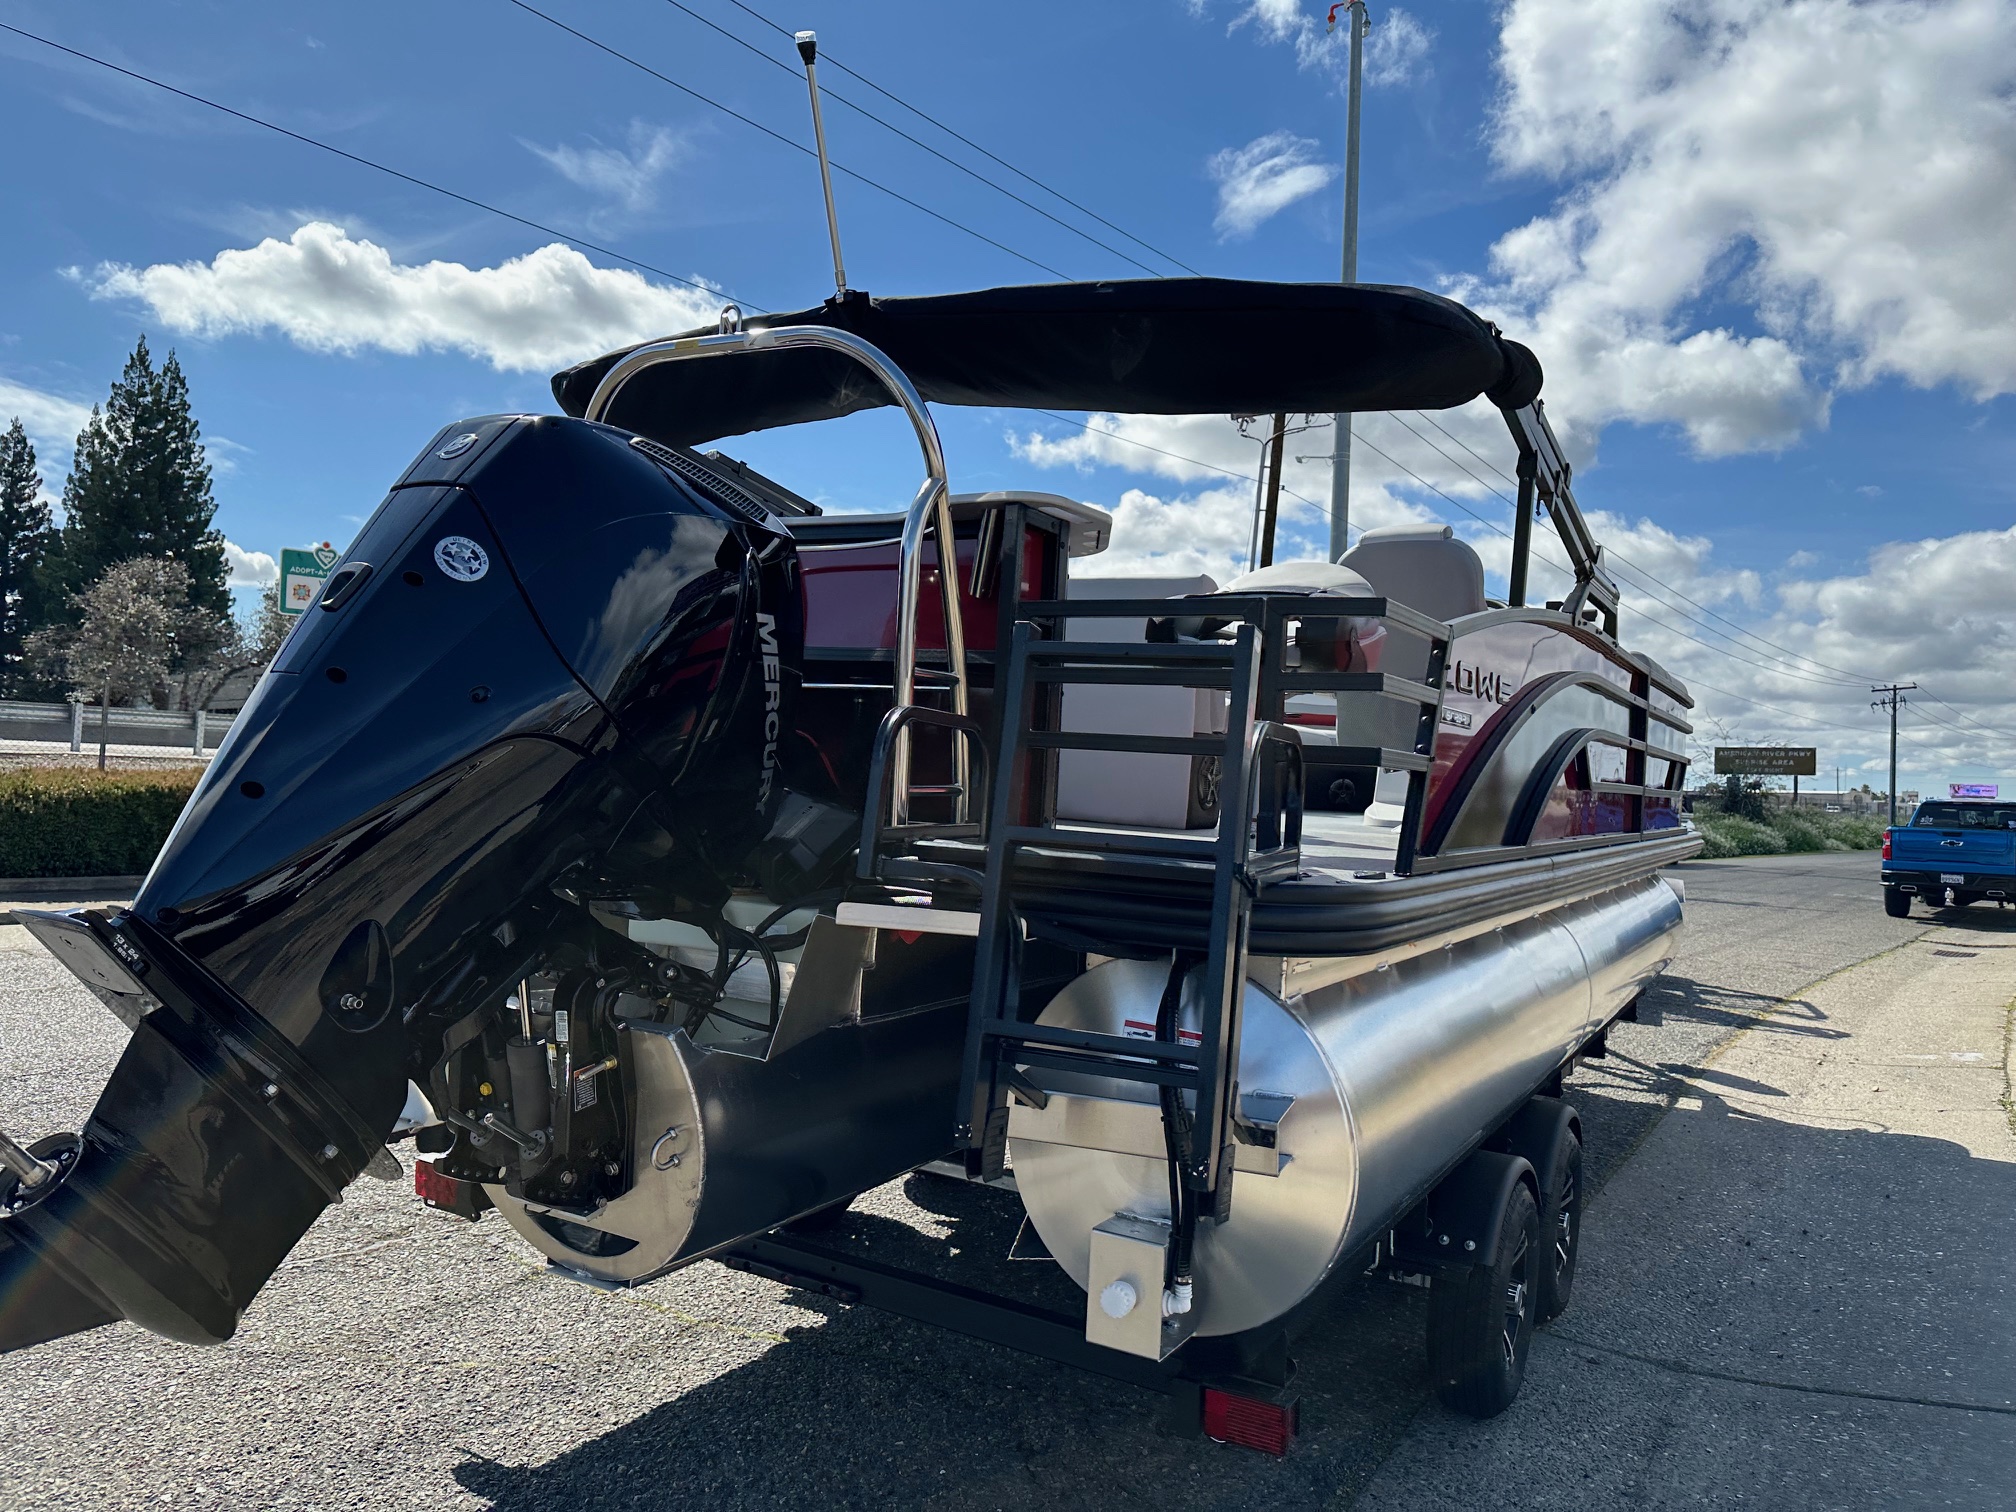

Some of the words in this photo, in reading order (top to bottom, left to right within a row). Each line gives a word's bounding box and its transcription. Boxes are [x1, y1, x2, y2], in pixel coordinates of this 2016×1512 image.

[452, 536, 477, 549] ULTRA
[478, 549, 488, 566] LOW
[755, 612, 781, 817] MERCURY
[115, 934, 125, 944] 13
[127, 948, 139, 960] 24
